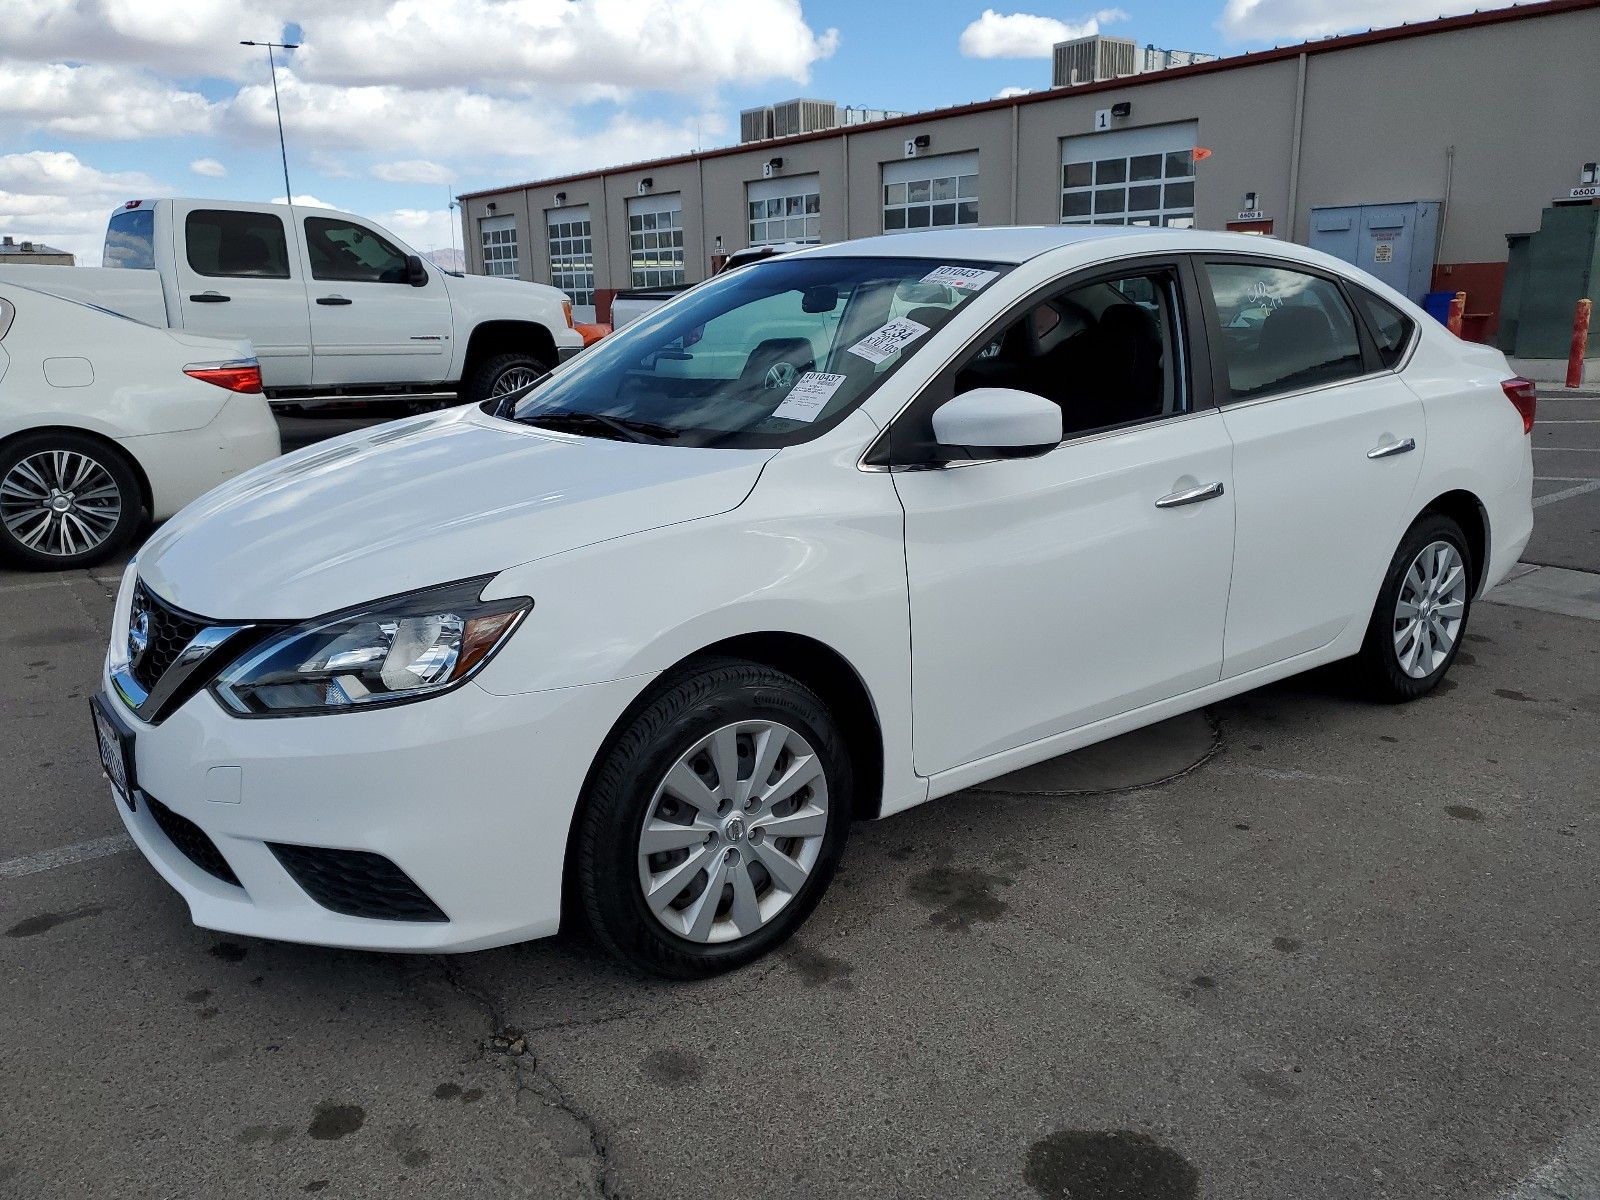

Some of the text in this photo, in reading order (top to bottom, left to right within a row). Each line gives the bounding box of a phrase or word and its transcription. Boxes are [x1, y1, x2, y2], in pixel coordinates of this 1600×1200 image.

[1100, 113, 1106, 127] 1
[908, 142, 914, 154] 2
[765, 164, 770, 175] 3
[937, 267, 986, 279] 1010437
[881, 324, 914, 341] 2:34
[805, 372, 842, 383] 1010437
